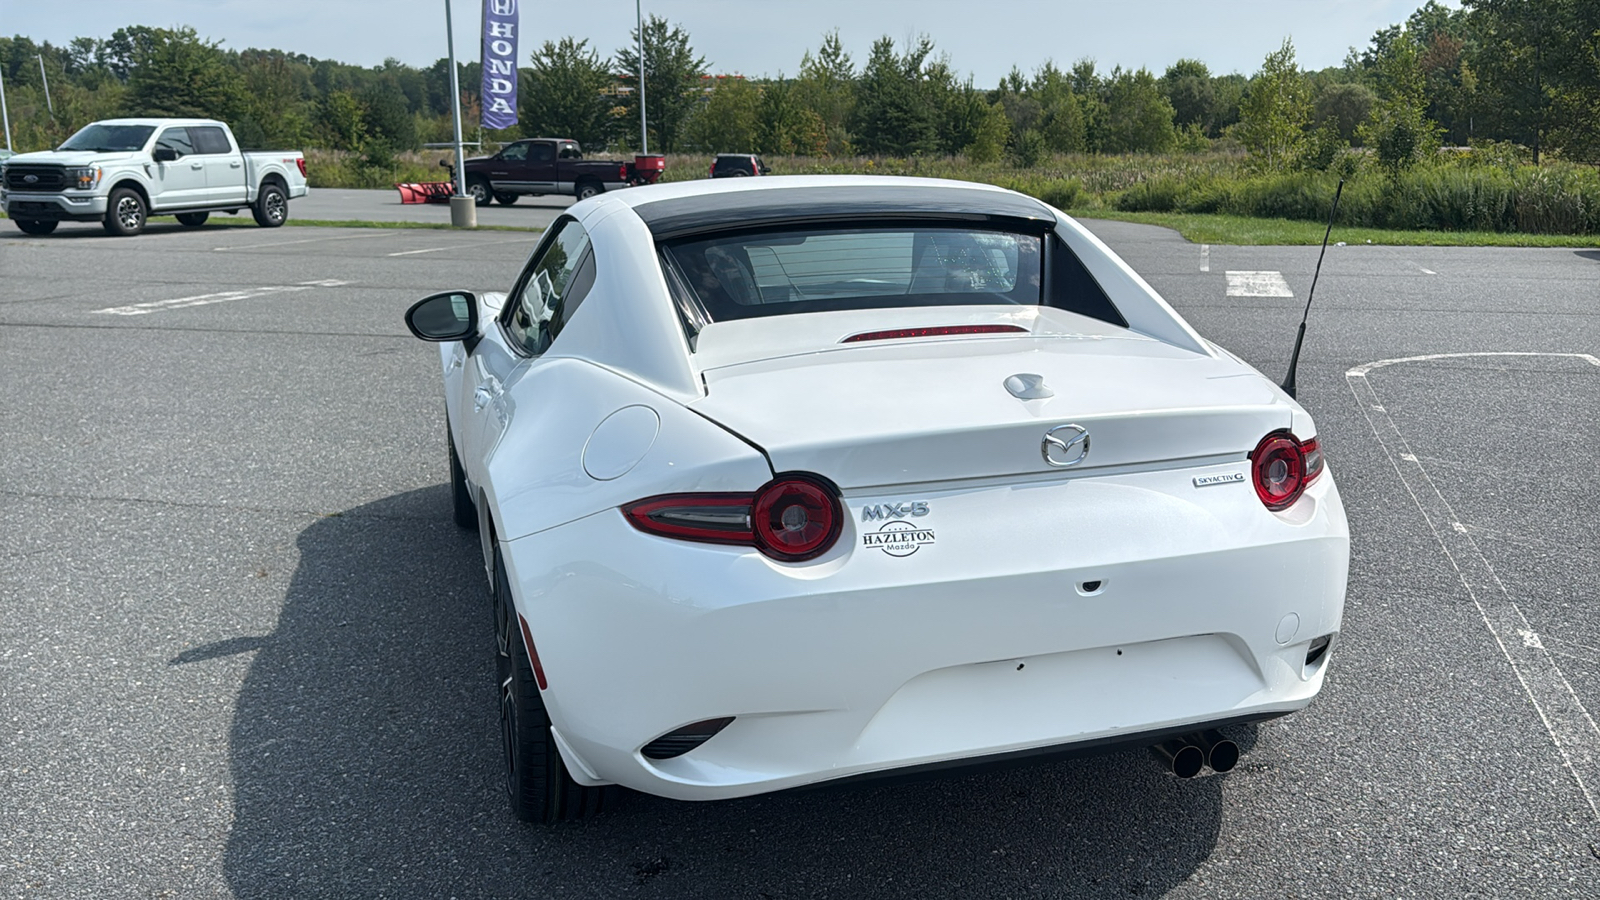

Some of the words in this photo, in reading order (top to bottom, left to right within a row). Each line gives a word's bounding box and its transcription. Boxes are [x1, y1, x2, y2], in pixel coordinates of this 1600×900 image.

[490, 21, 514, 113] HONDA
[862, 501, 930, 521] MX-5
[863, 531, 935, 545] HAZLETON
[886, 543, 915, 551] Mazda
